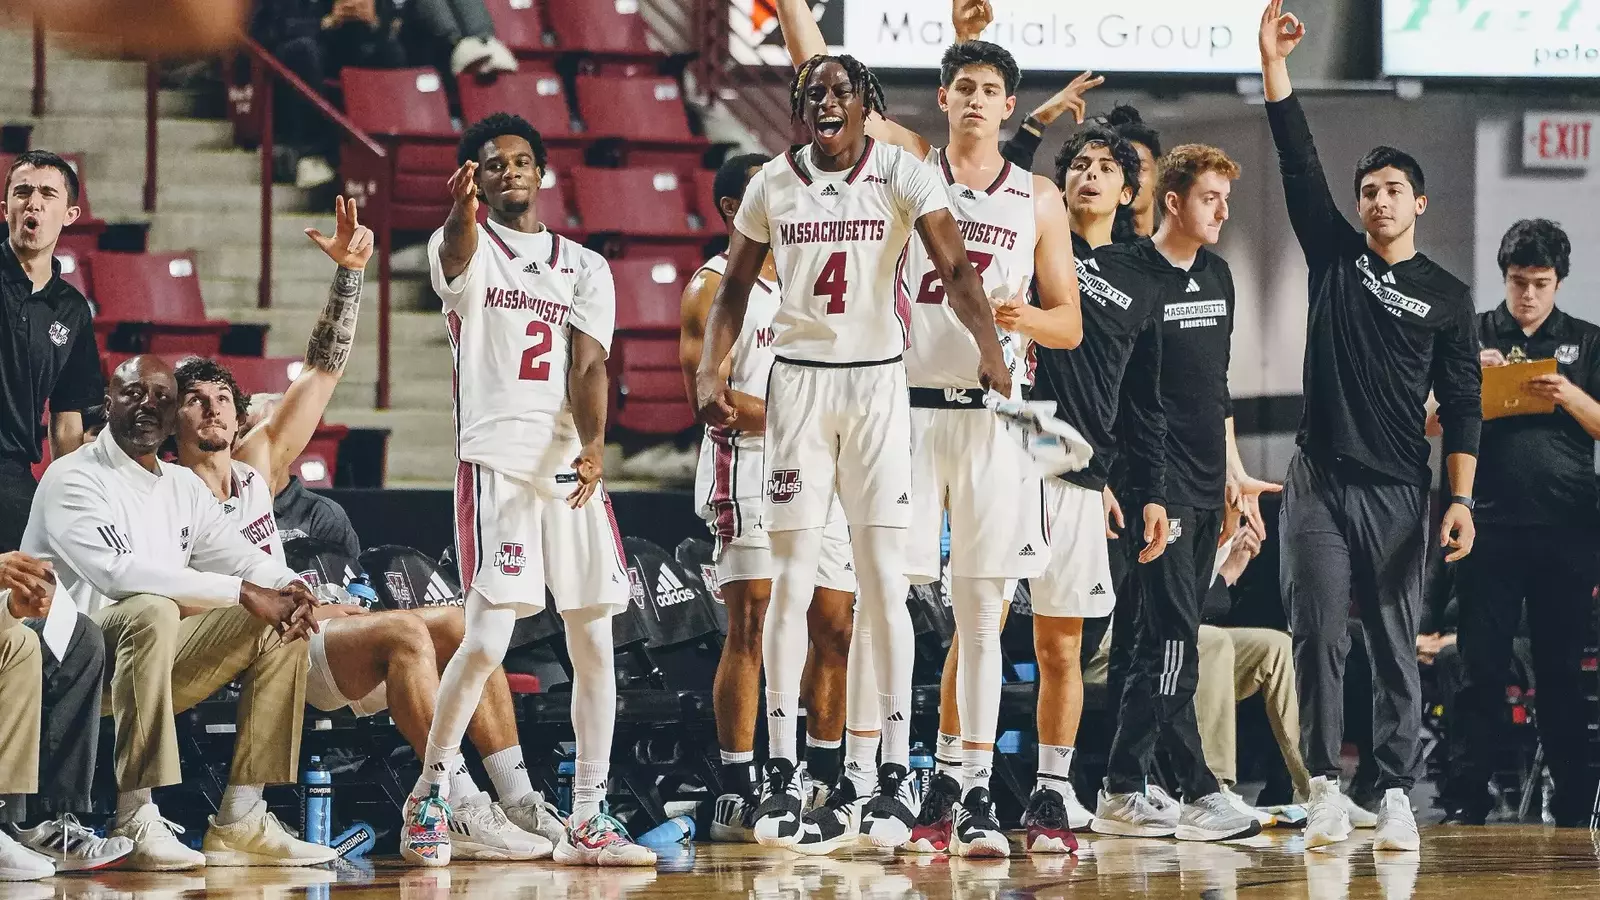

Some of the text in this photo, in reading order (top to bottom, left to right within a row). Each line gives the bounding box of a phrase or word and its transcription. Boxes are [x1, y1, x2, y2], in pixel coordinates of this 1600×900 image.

[877, 11, 1233, 57] Marials Group
[1537, 118, 1592, 161] EXIT
[780, 219, 885, 246] MASSACHUSETTS
[956, 219, 1017, 251] HUSETTS
[813, 251, 848, 315] 4
[1164, 303, 1225, 318] MASSACHUSETTS
[518, 320, 553, 382] 2
[656, 588, 695, 608] adidas
[335, 829, 369, 856] POWERAD
